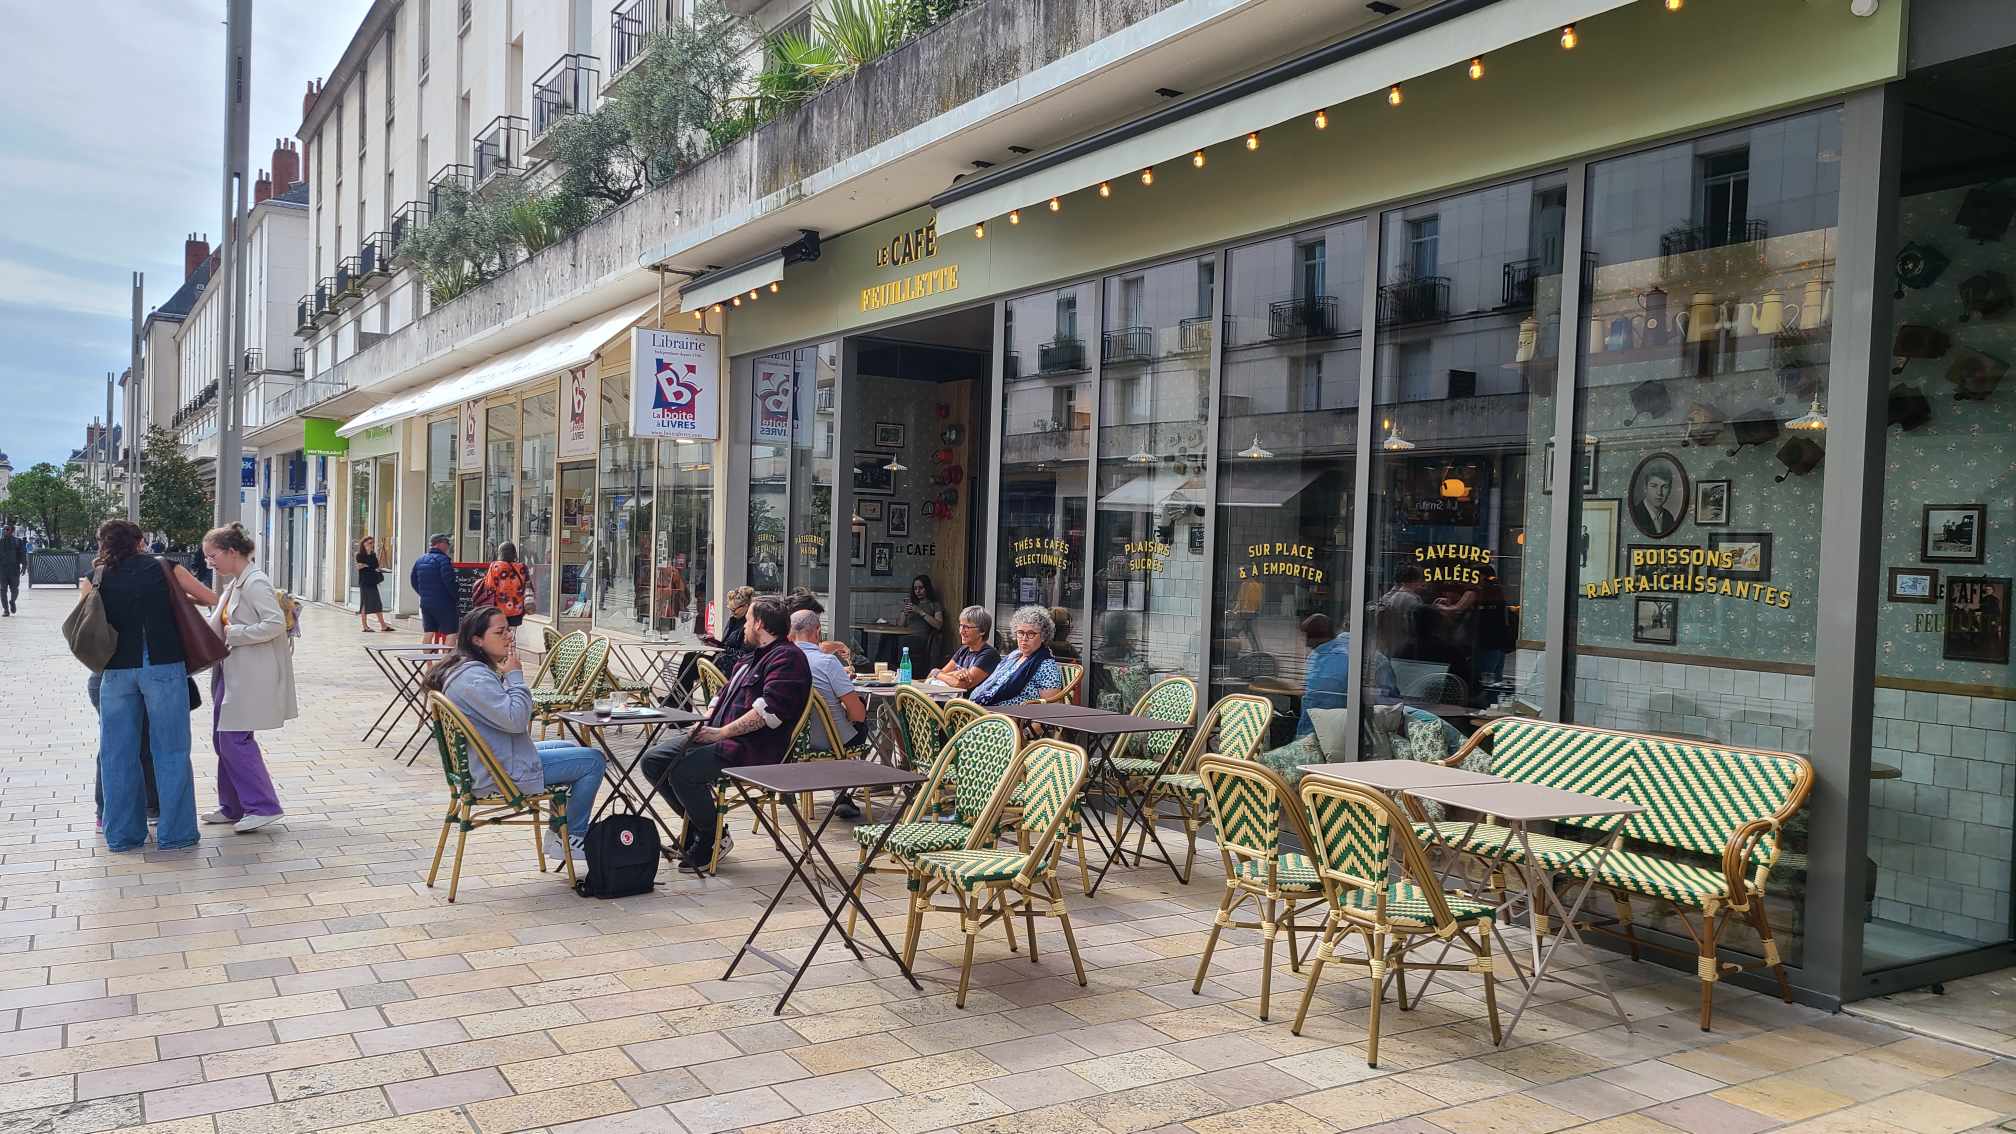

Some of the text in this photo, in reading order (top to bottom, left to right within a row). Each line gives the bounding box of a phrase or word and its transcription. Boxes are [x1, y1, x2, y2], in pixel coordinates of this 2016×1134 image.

[876, 215, 937, 267] LE CAFÉ
[861, 264, 959, 312] FEUILLETTE
[652, 333, 706, 352] Librairie
[661, 420, 696, 430] LIVRES
[906, 541, 937, 557] CAFÉ
[1124, 540, 1170, 557] PLAISIRS
[1248, 542, 1315, 560] SUR PLACE
[1415, 543, 1492, 565] SAVEURS
[1632, 548, 1735, 570] BOISSONS
[1239, 566, 1248, 580] &
[1263, 562, 1324, 584] EMPORTER
[1423, 563, 1481, 585] SALÉES
